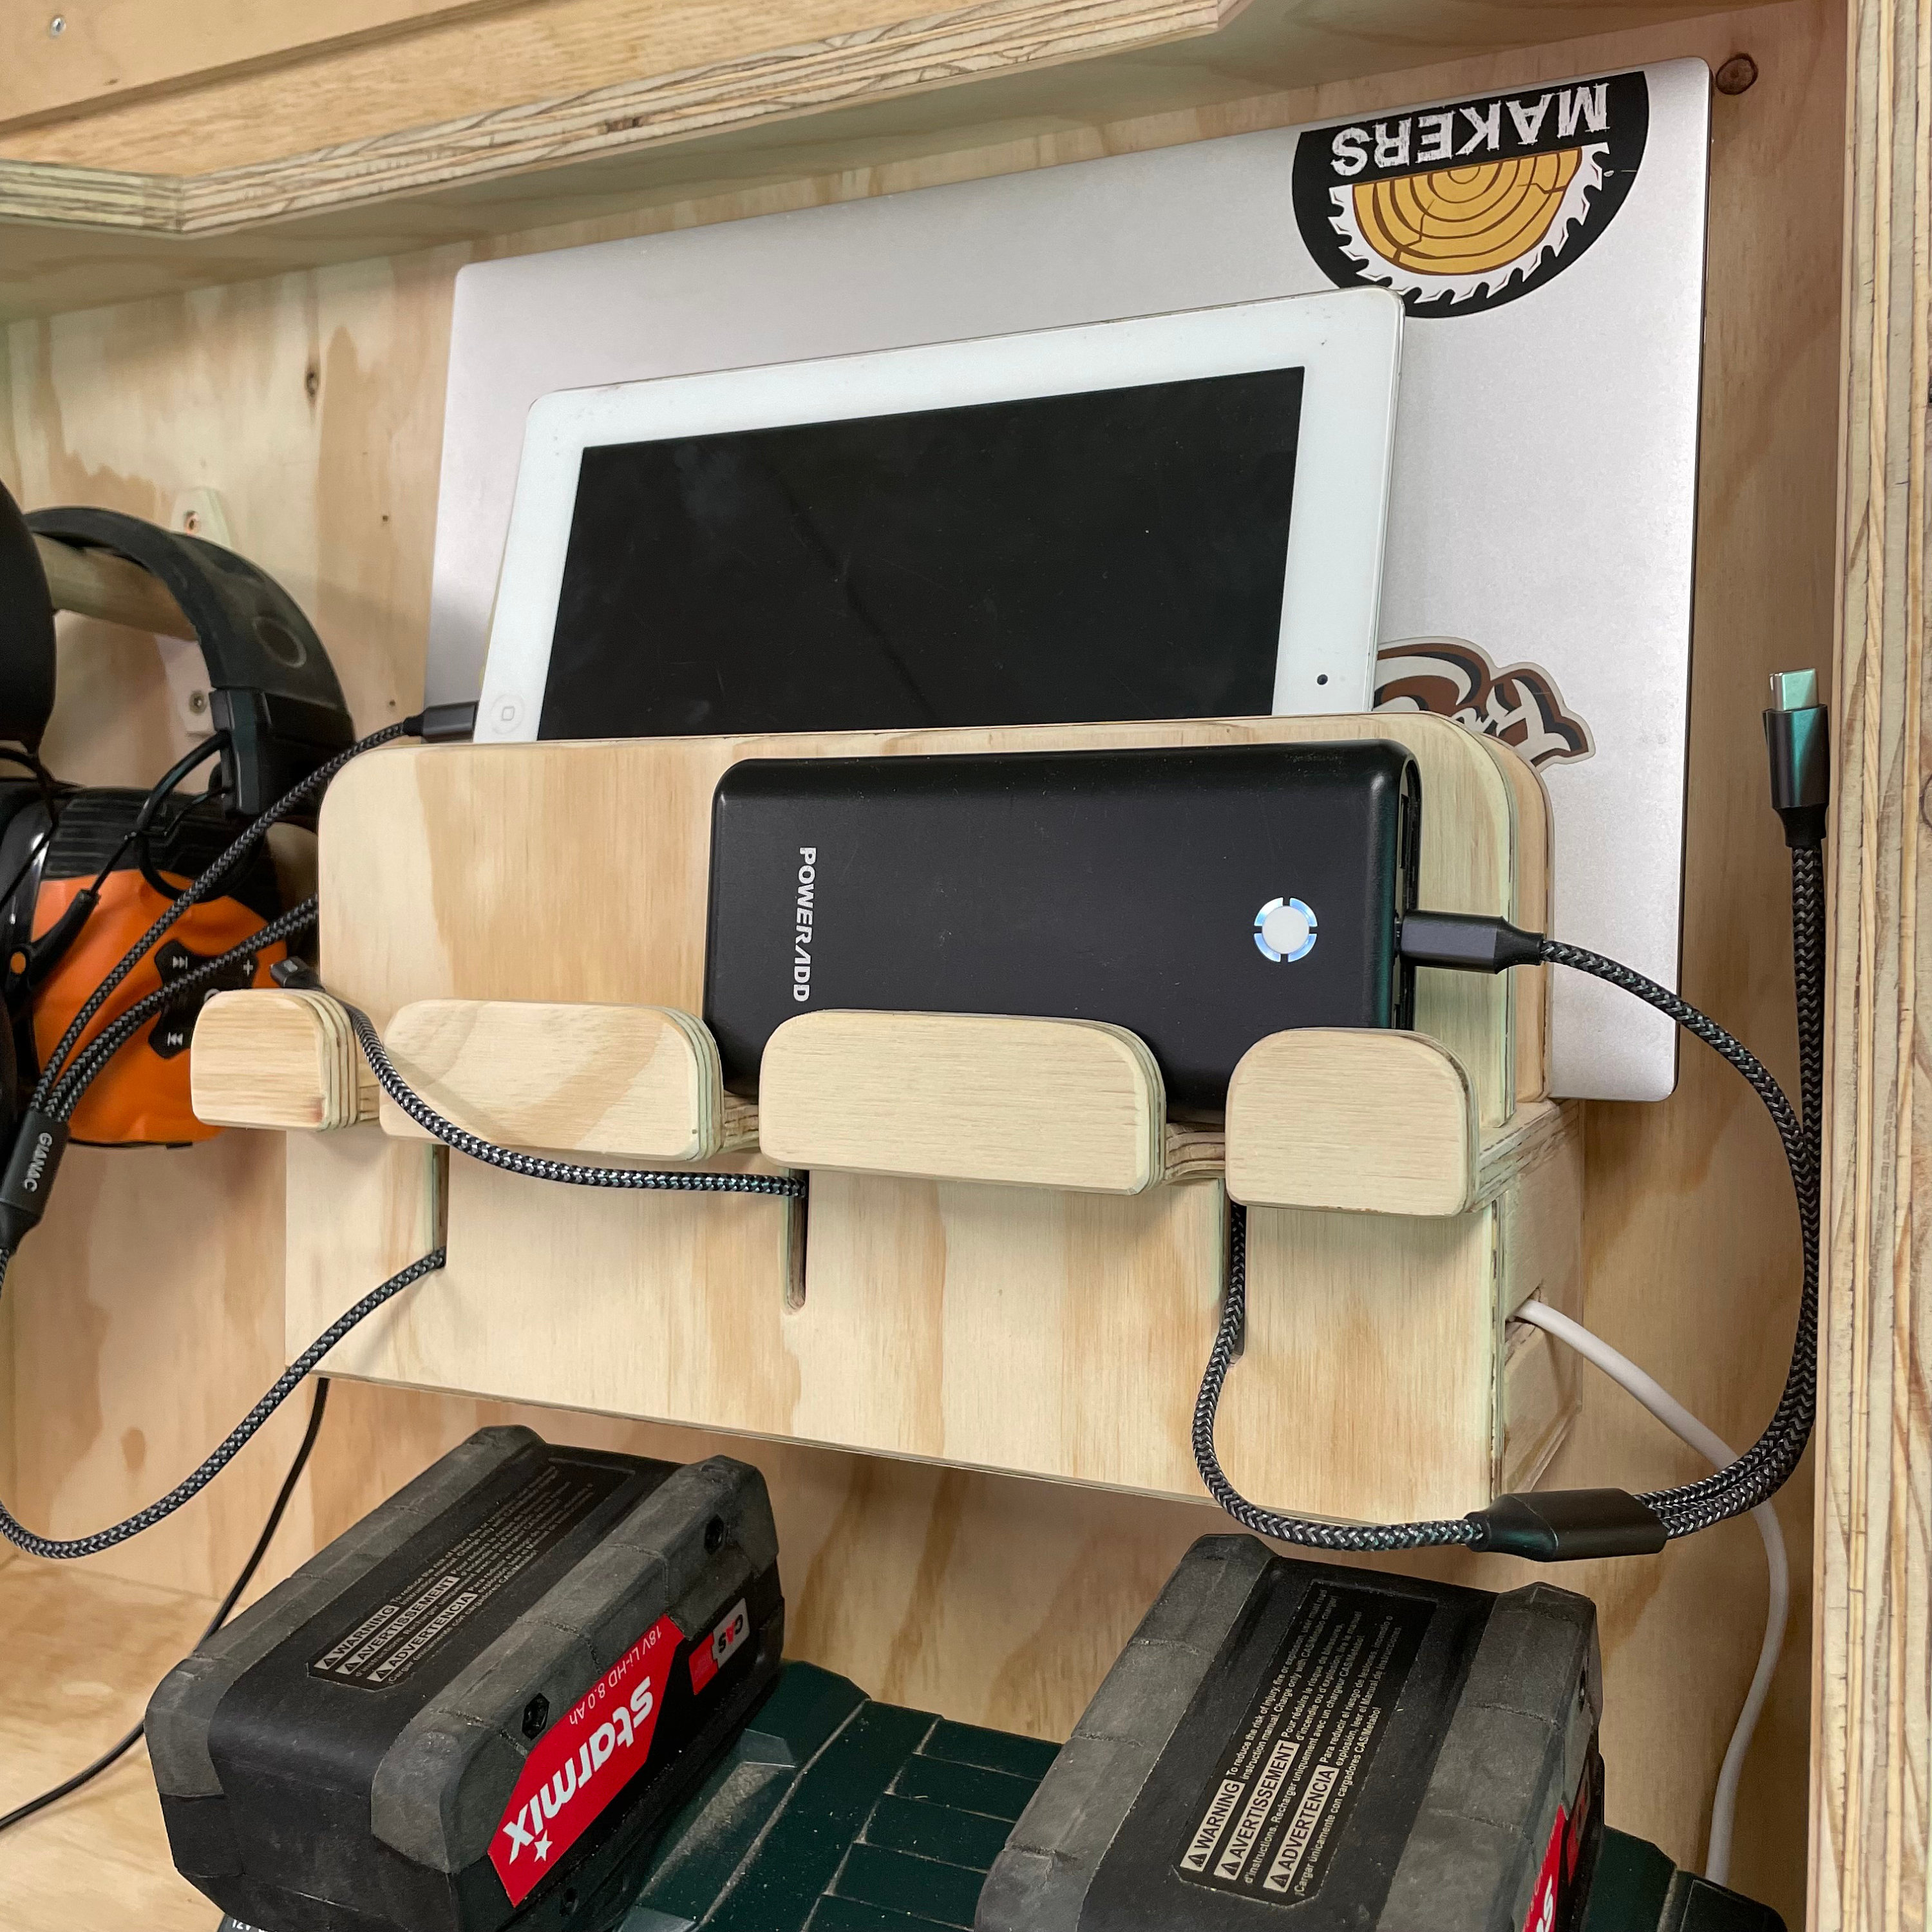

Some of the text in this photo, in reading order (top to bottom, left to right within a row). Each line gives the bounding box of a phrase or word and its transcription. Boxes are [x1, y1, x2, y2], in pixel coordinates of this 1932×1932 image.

[1330, 82, 1611, 176] MAKERS
[793, 847, 817, 1002] POWERADD
[333, 1607, 395, 1654] WARNING
[357, 1578, 453, 1660] AVERTISSEMENT
[389, 1596, 473, 1666] ADVERTENCIA
[569, 1625, 662, 1725] 18V Li-HD 8.0 Ah
[1273, 1688, 1293, 1712] Charge
[502, 1676, 654, 1866] starmix
[1226, 1766, 1238, 1776] To
[1233, 1741, 1251, 1766] reduce
[1245, 1728, 1258, 1740] the
[1252, 1714, 1265, 1728] risk
[1260, 1705, 1269, 1714] of
[1271, 1783, 1297, 1823] Recharger
[1293, 1738, 1318, 1781] uniquement
[1313, 1719, 1327, 1736] avec
[1326, 1678, 1345, 1709] chargeur
[1281, 1719, 1296, 1738] Pour
[1319, 1746, 1335, 1763] Para
[1330, 1719, 1347, 1745] reducir
[1195, 1783, 1240, 1849] WARNING
[1230, 1744, 1293, 1858] AVERTISSEMENT
[1278, 1771, 1334, 1871] ADVERTENCIA
[1307, 1815, 1336, 1862] únicamente
[1331, 1798, 1343, 1814] con
[1338, 1754, 1361, 1797] cargadores
